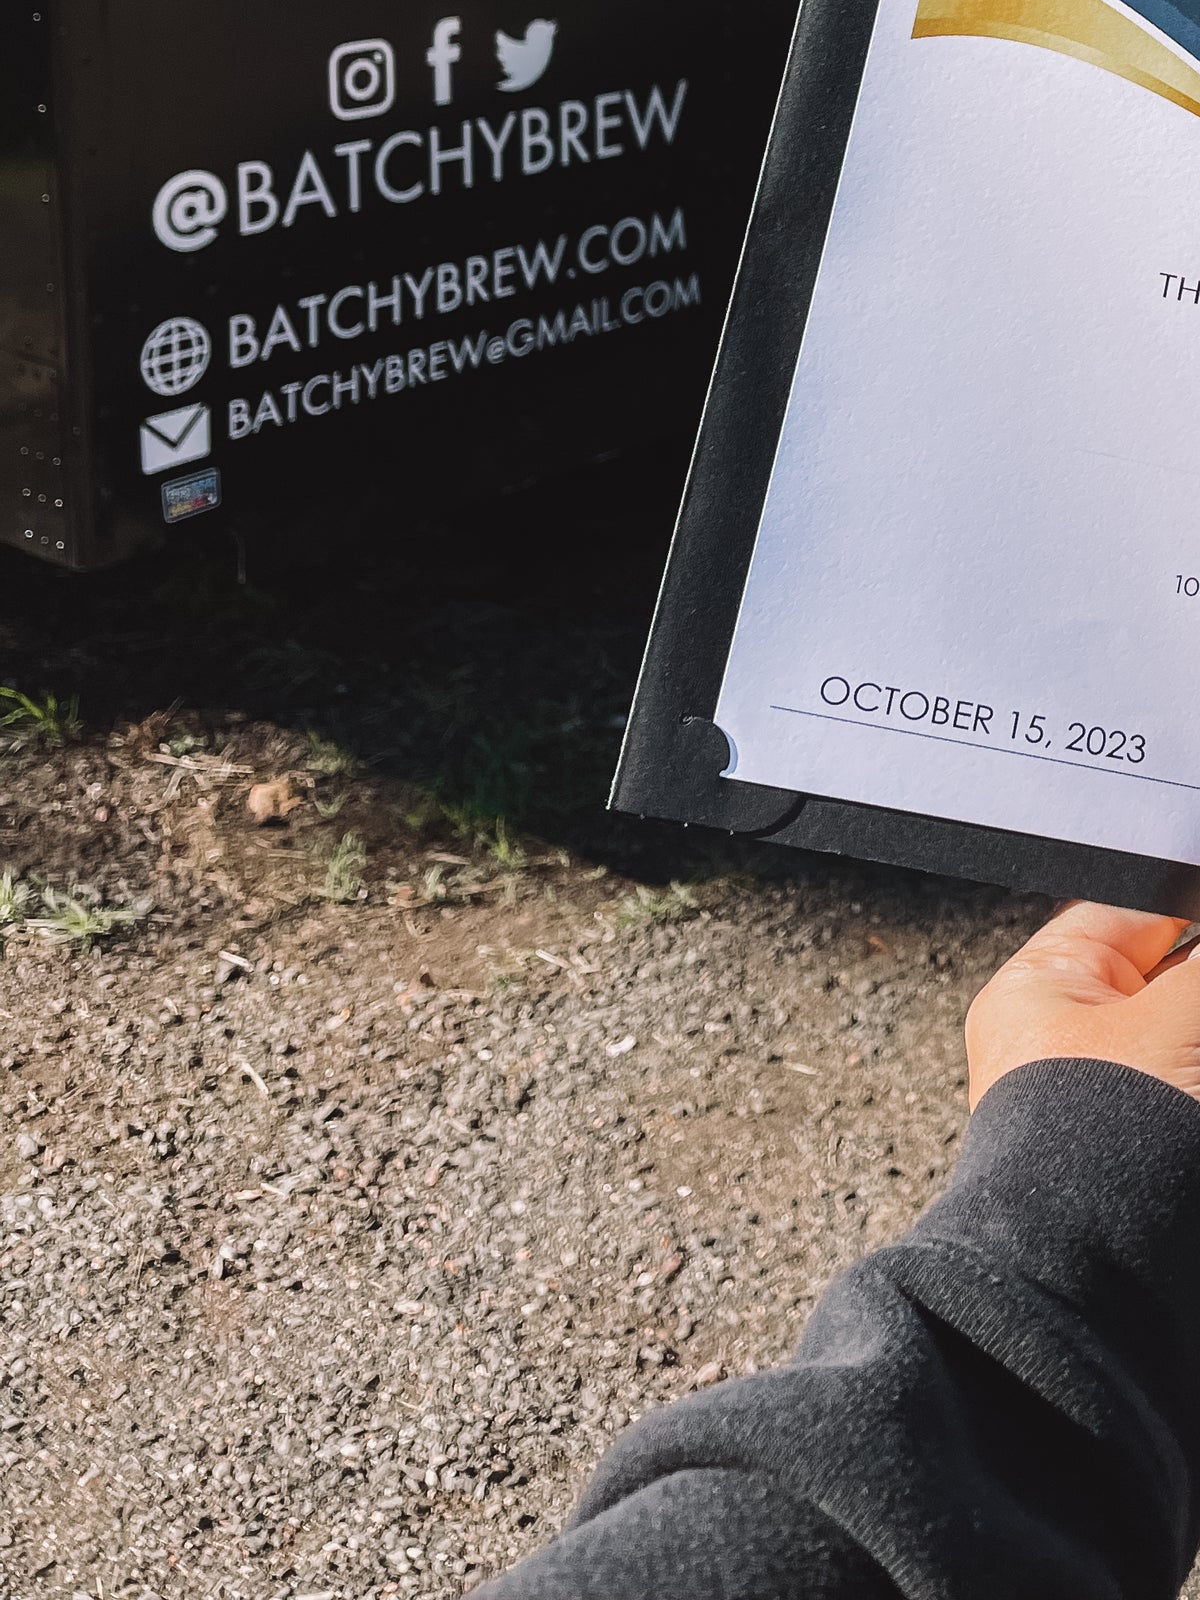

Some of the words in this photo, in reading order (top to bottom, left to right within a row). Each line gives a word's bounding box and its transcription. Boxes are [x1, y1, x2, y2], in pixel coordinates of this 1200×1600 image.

[152, 77, 689, 254] @BATCHYBREW
[228, 207, 688, 368] BATCHYBREW.COM
[819, 675, 995, 736] OCTOBER
[1009, 710, 1053, 750] 15,
[1064, 721, 1148, 765] 2023
